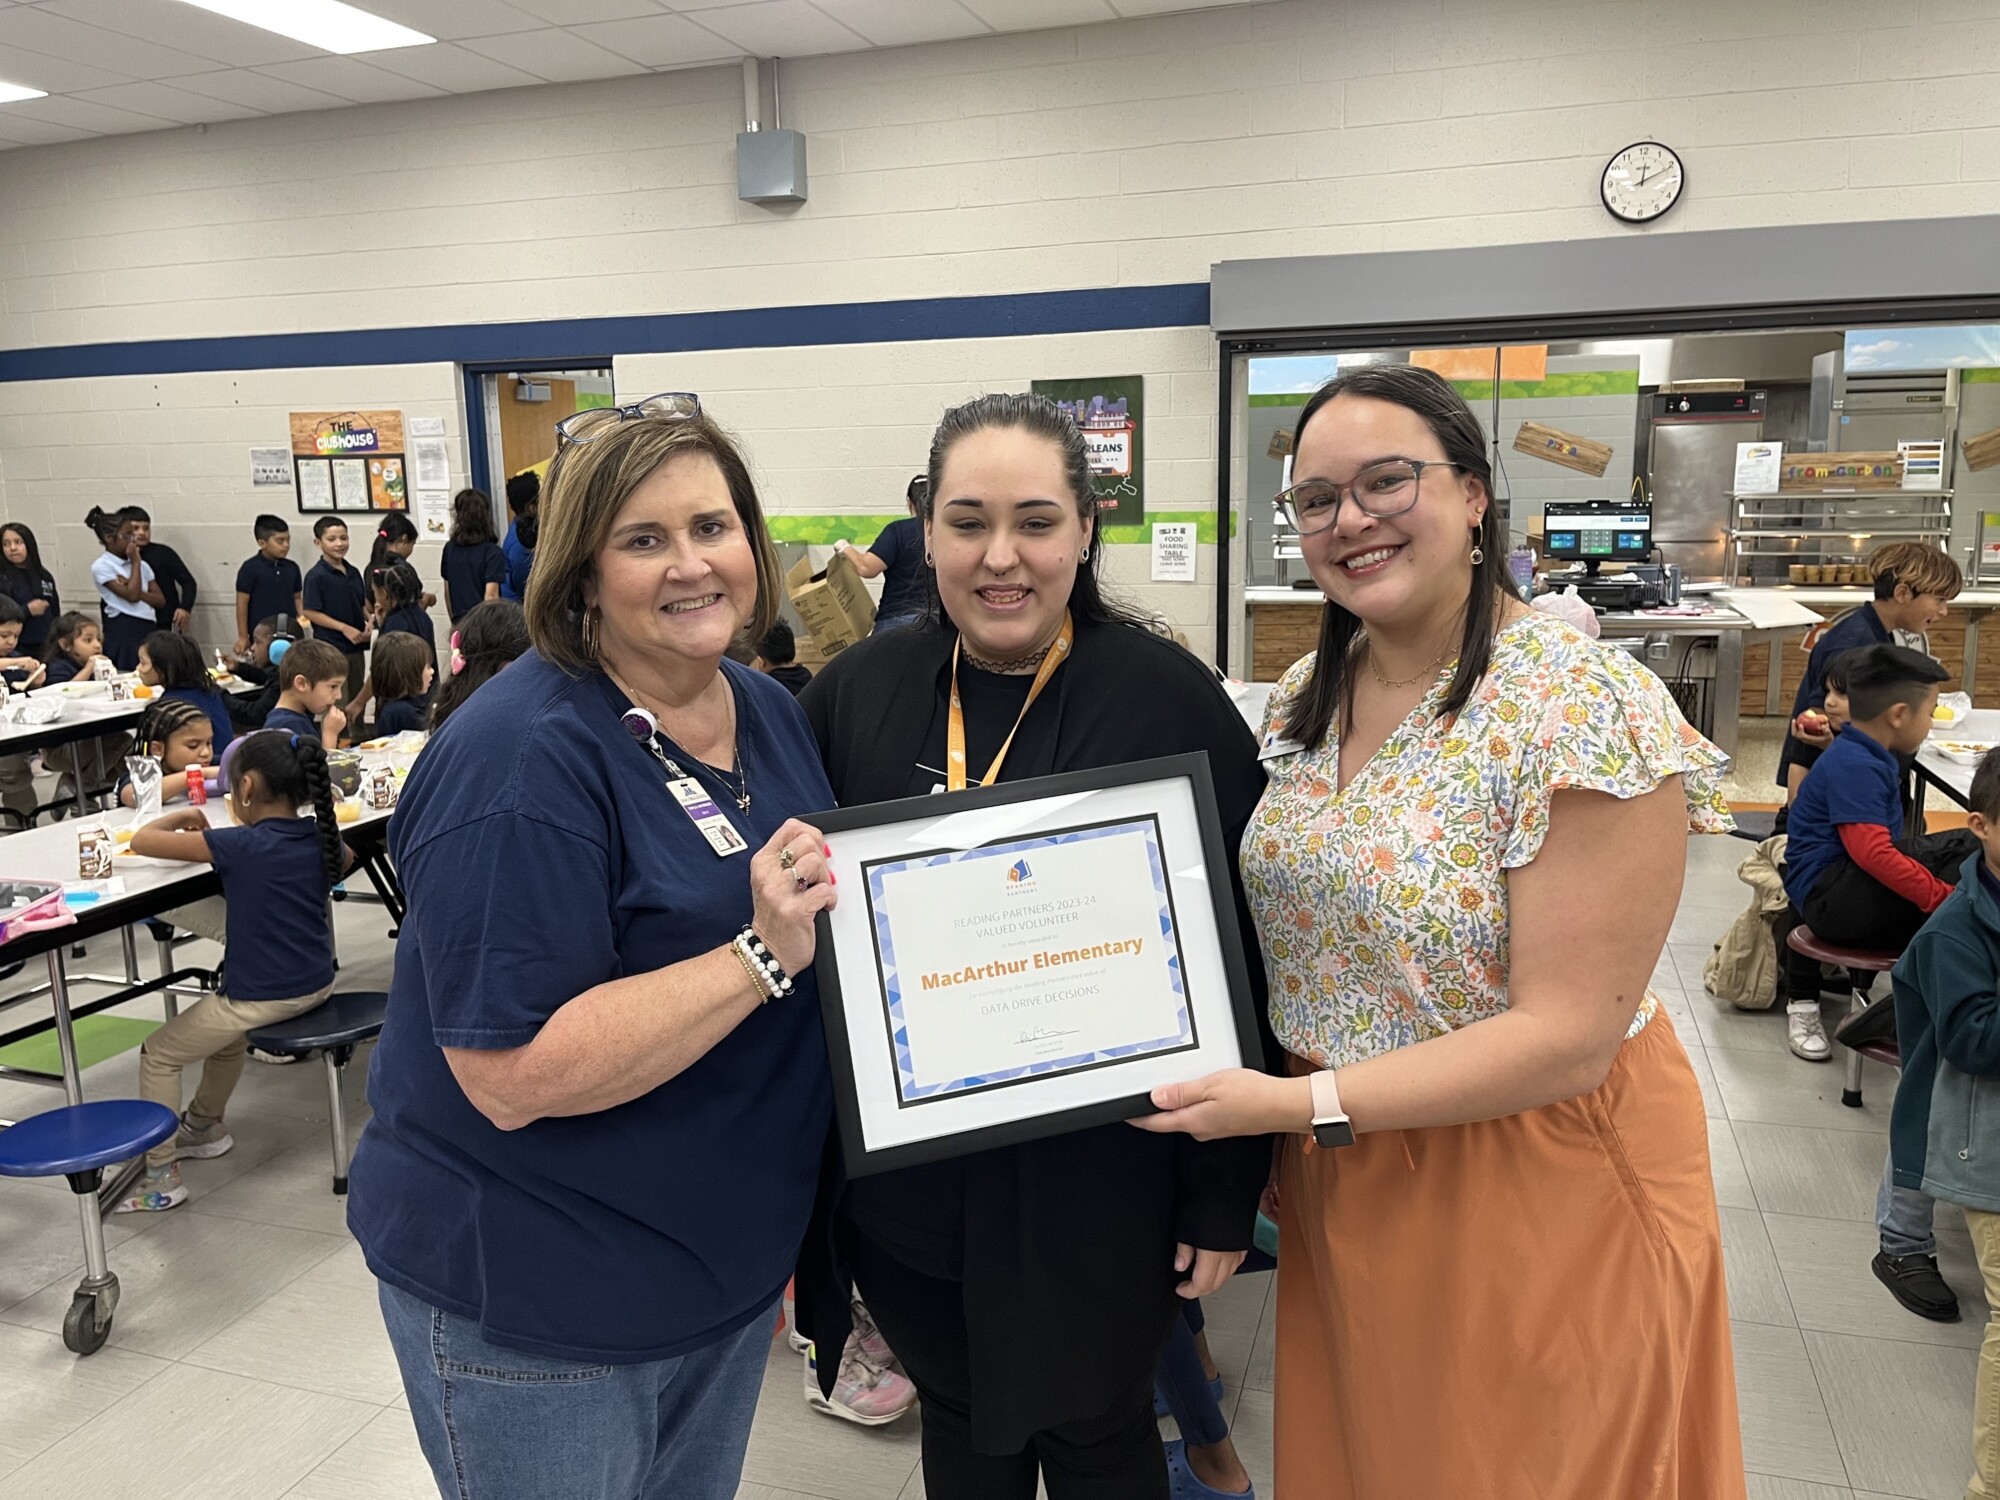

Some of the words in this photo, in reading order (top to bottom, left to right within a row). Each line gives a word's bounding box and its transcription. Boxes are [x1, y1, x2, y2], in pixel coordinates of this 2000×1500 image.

[1640, 147, 1649, 156] 12
[1622, 153, 1631, 161] 11
[1669, 161, 1675, 169] 2
[1611, 196, 1616, 204] 8
[1654, 204, 1660, 212] 5
[1637, 209, 1643, 217] 6
[329, 421, 353, 432] THE
[1087, 443, 1123, 453] RLEANS
[1006, 881, 1037, 890] READING
[1007, 888, 1038, 897] PARTNERS
[954, 911, 1001, 928] READING
[1003, 903, 1055, 920] PARTNERS
[1057, 895, 1097, 910] 2023-24
[976, 923, 1017, 939] VALUED
[1018, 912, 1080, 931] VOLUNTEER
[921, 958, 1029, 991] MacArthur
[1033, 937, 1144, 970] Elementary
[981, 1004, 1010, 1016] DATA
[1012, 995, 1043, 1010] DRIVE
[1044, 984, 1100, 1003] DECISIONS
